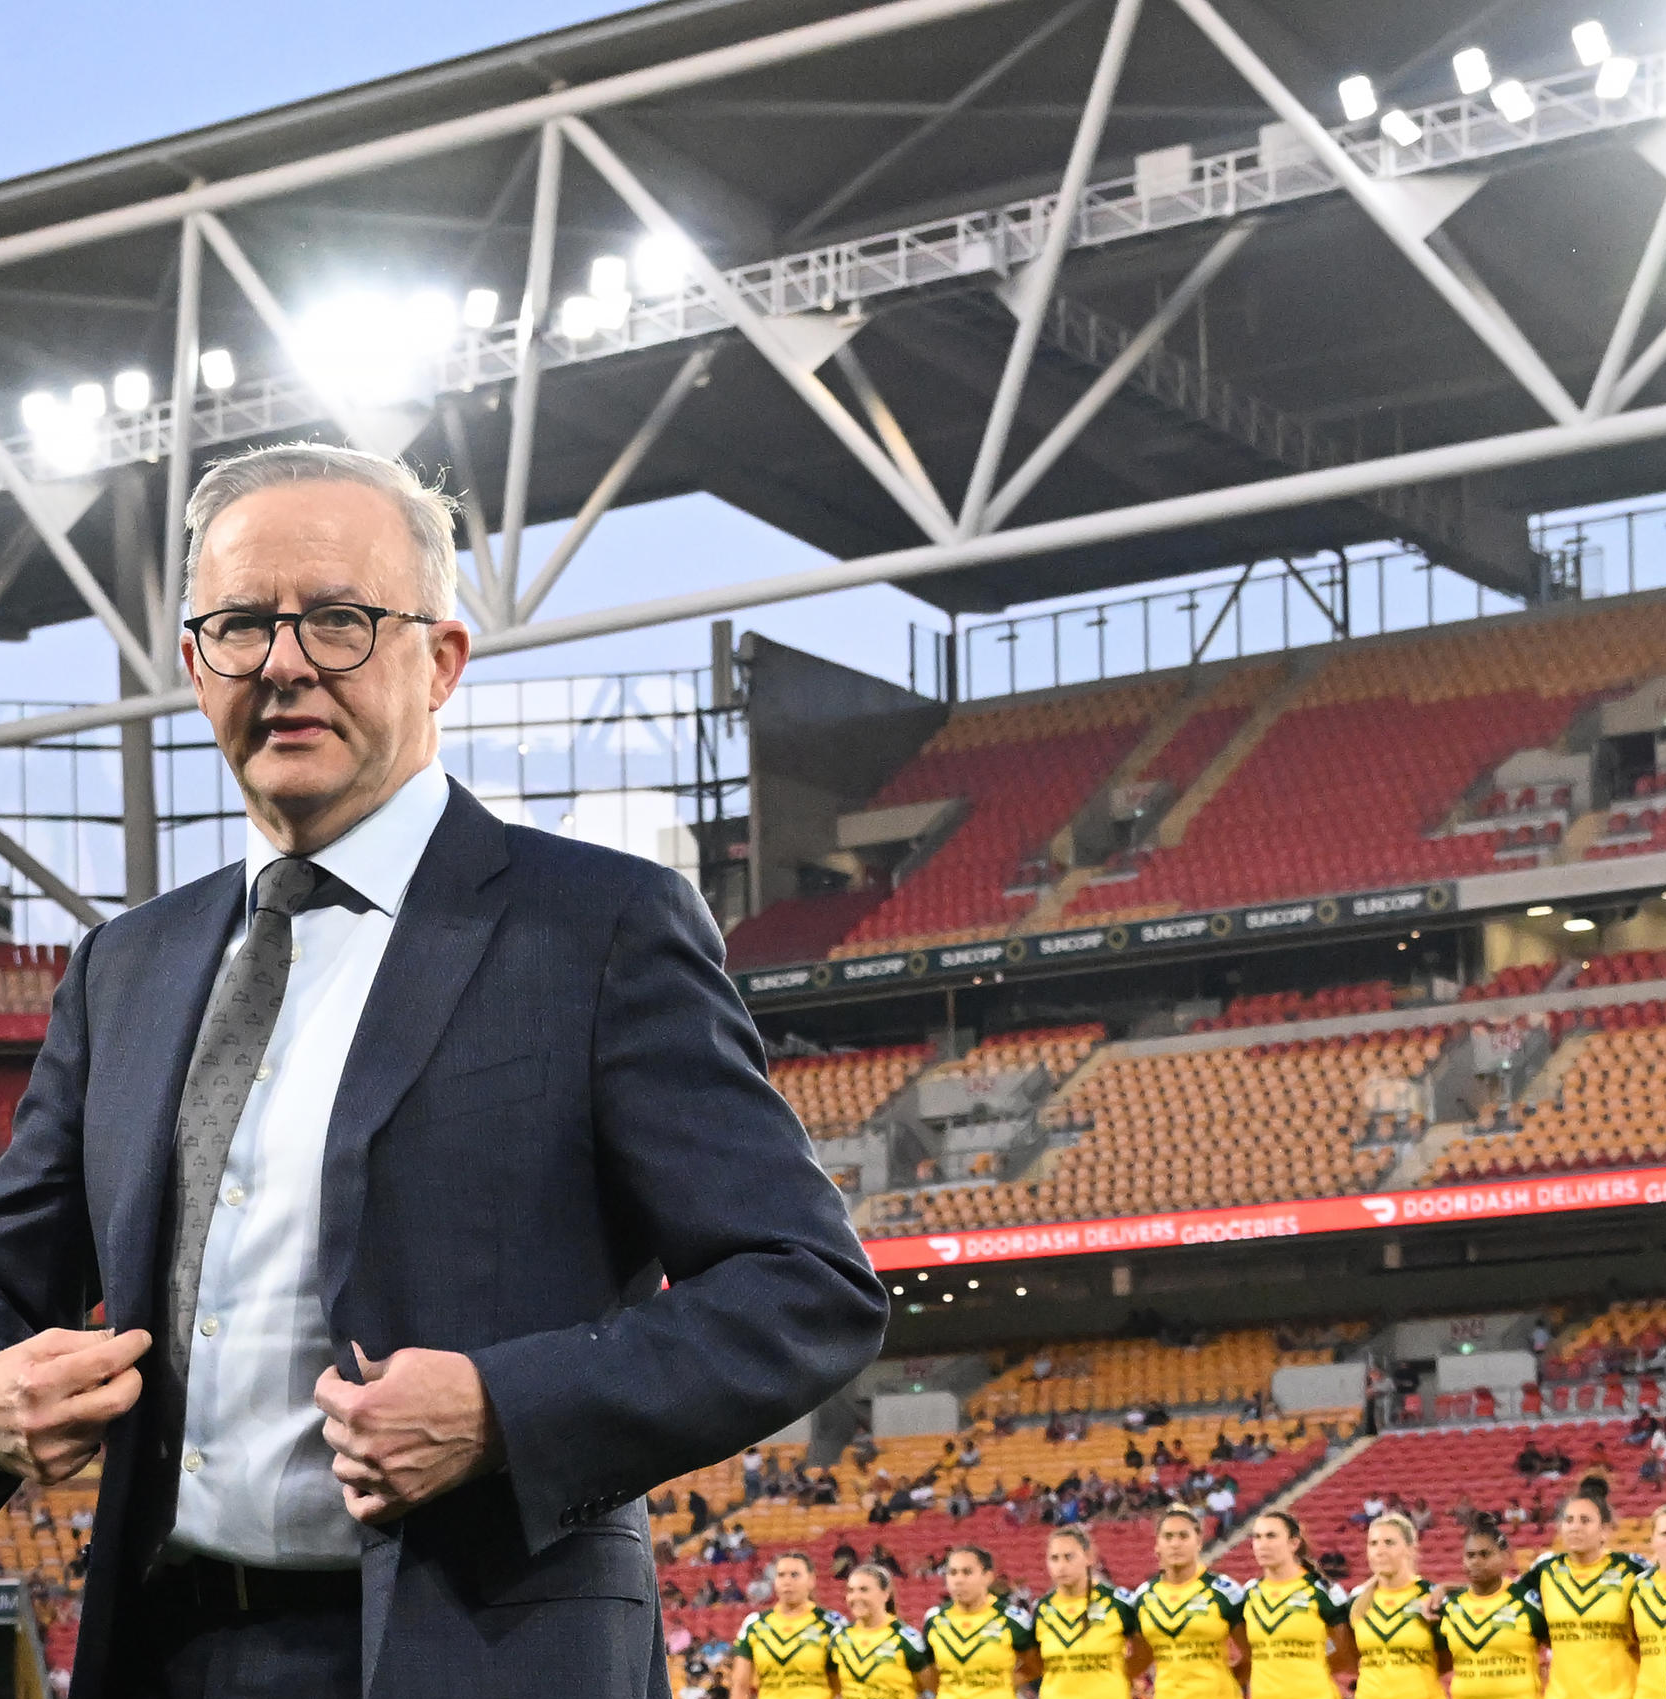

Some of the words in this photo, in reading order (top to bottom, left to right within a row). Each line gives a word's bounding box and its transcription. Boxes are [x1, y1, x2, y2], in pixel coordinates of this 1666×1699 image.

[1403, 1190, 1529, 1218] DOORDASH
[1537, 1178, 1638, 1207] DELIVERS
[965, 1231, 1079, 1257] DOORDASH
[1084, 1220, 1175, 1247] DELIVERS
[1181, 1216, 1298, 1245] GROCERIES
